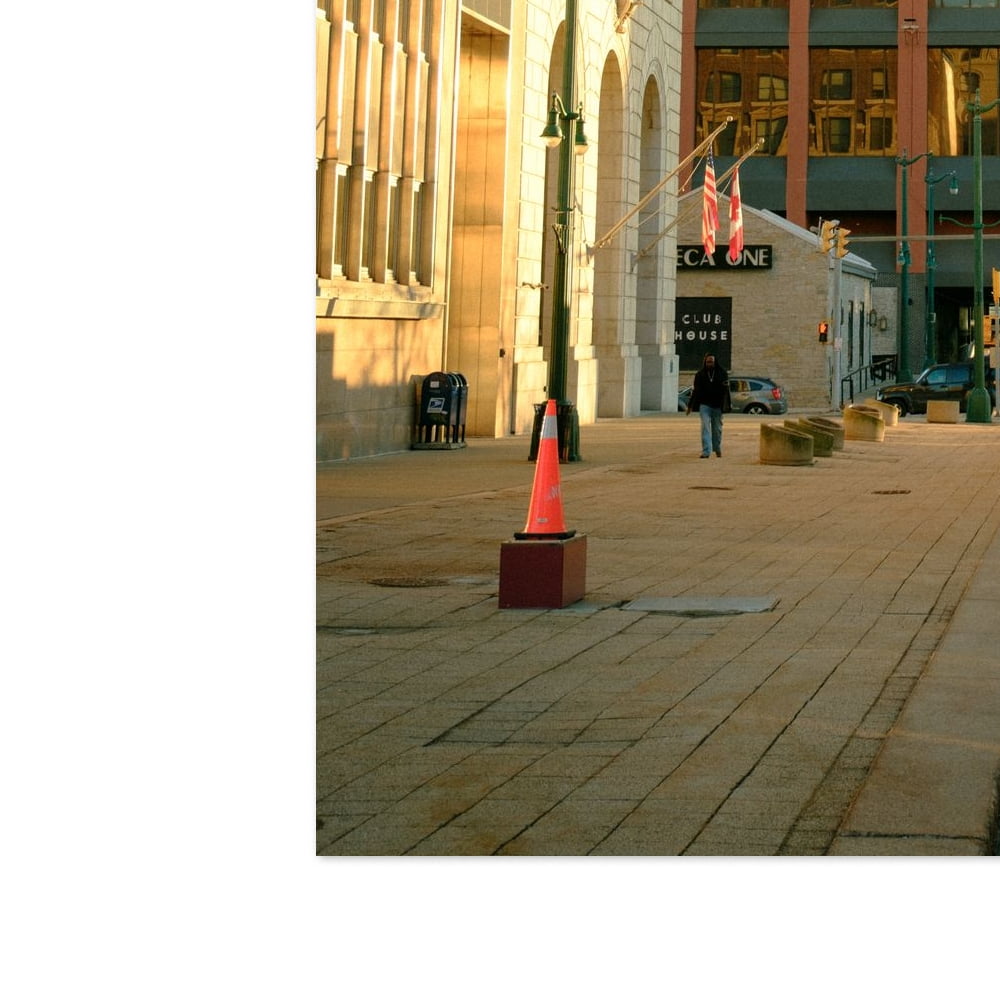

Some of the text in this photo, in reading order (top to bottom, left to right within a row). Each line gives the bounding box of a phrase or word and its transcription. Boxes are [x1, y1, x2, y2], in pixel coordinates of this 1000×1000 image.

[725, 248, 769, 267] ONE
[681, 313, 722, 325] CLUB
[675, 330, 728, 341] HOUSE
